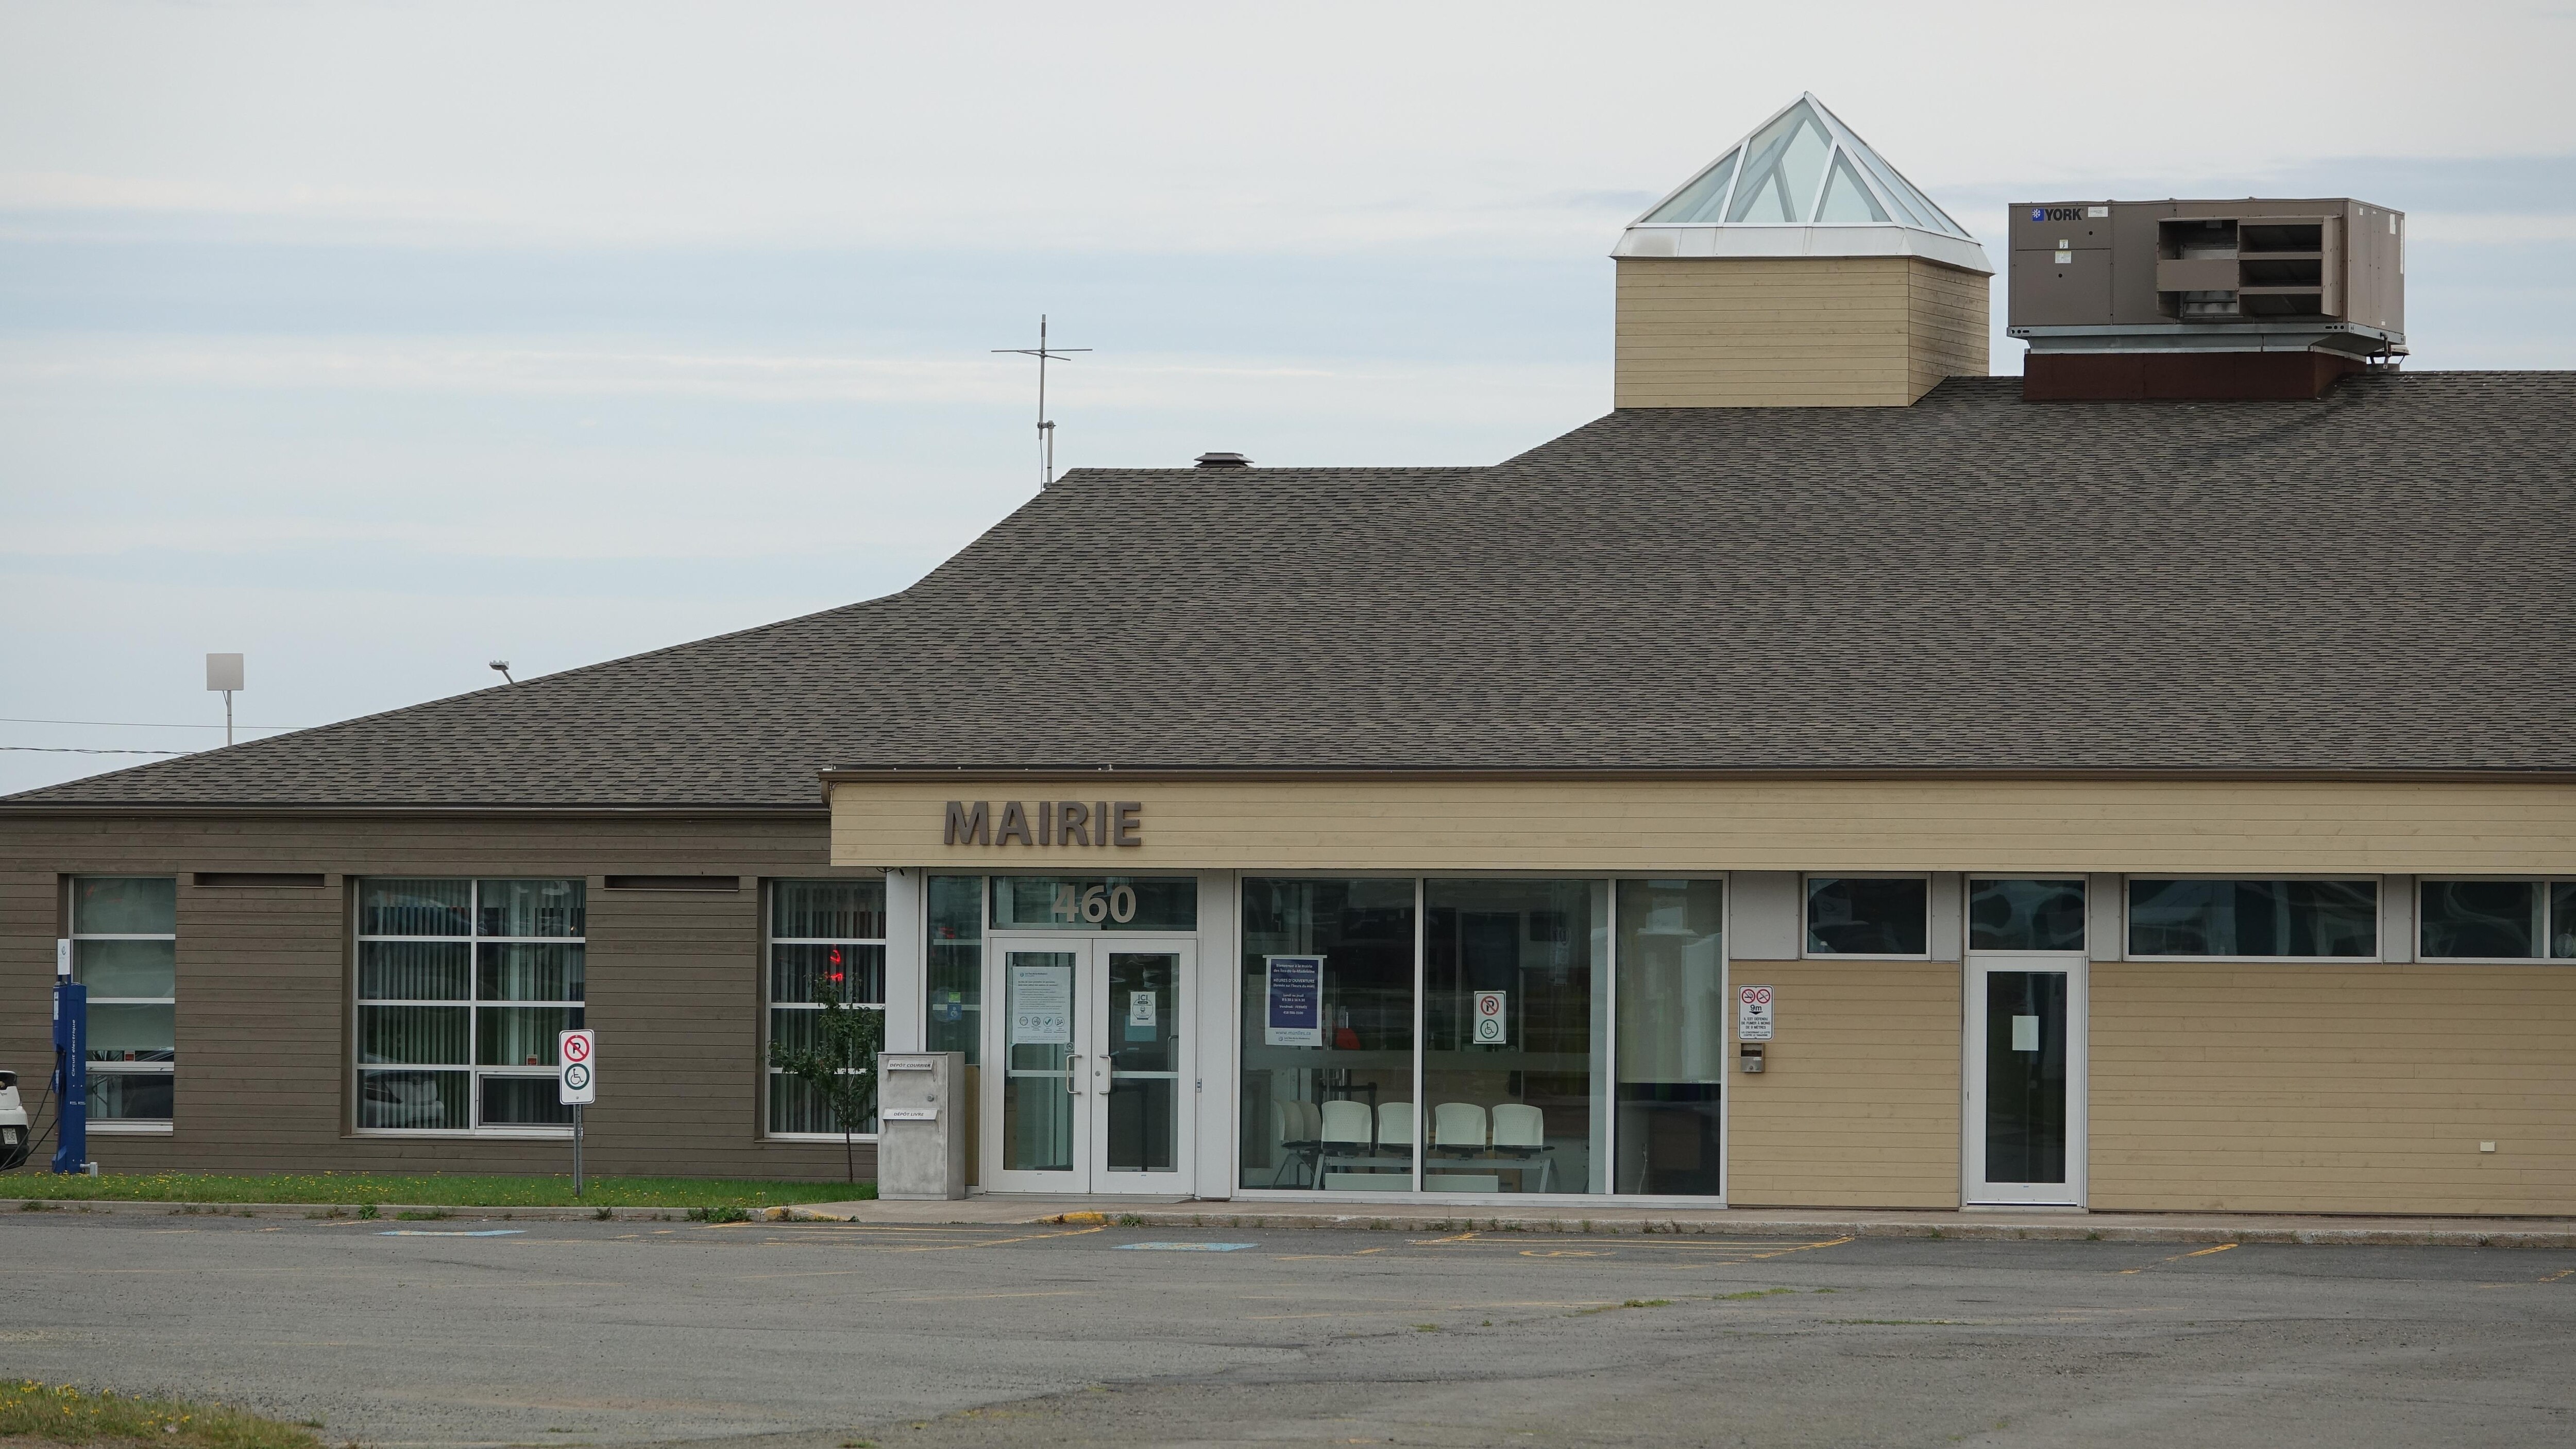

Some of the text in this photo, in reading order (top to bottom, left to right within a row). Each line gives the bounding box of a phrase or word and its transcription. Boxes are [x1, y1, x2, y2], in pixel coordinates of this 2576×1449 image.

[2045, 208, 2082, 221] YORK
[944, 801, 1141, 846] MAIRIE
[1053, 885, 1136, 923] 460
